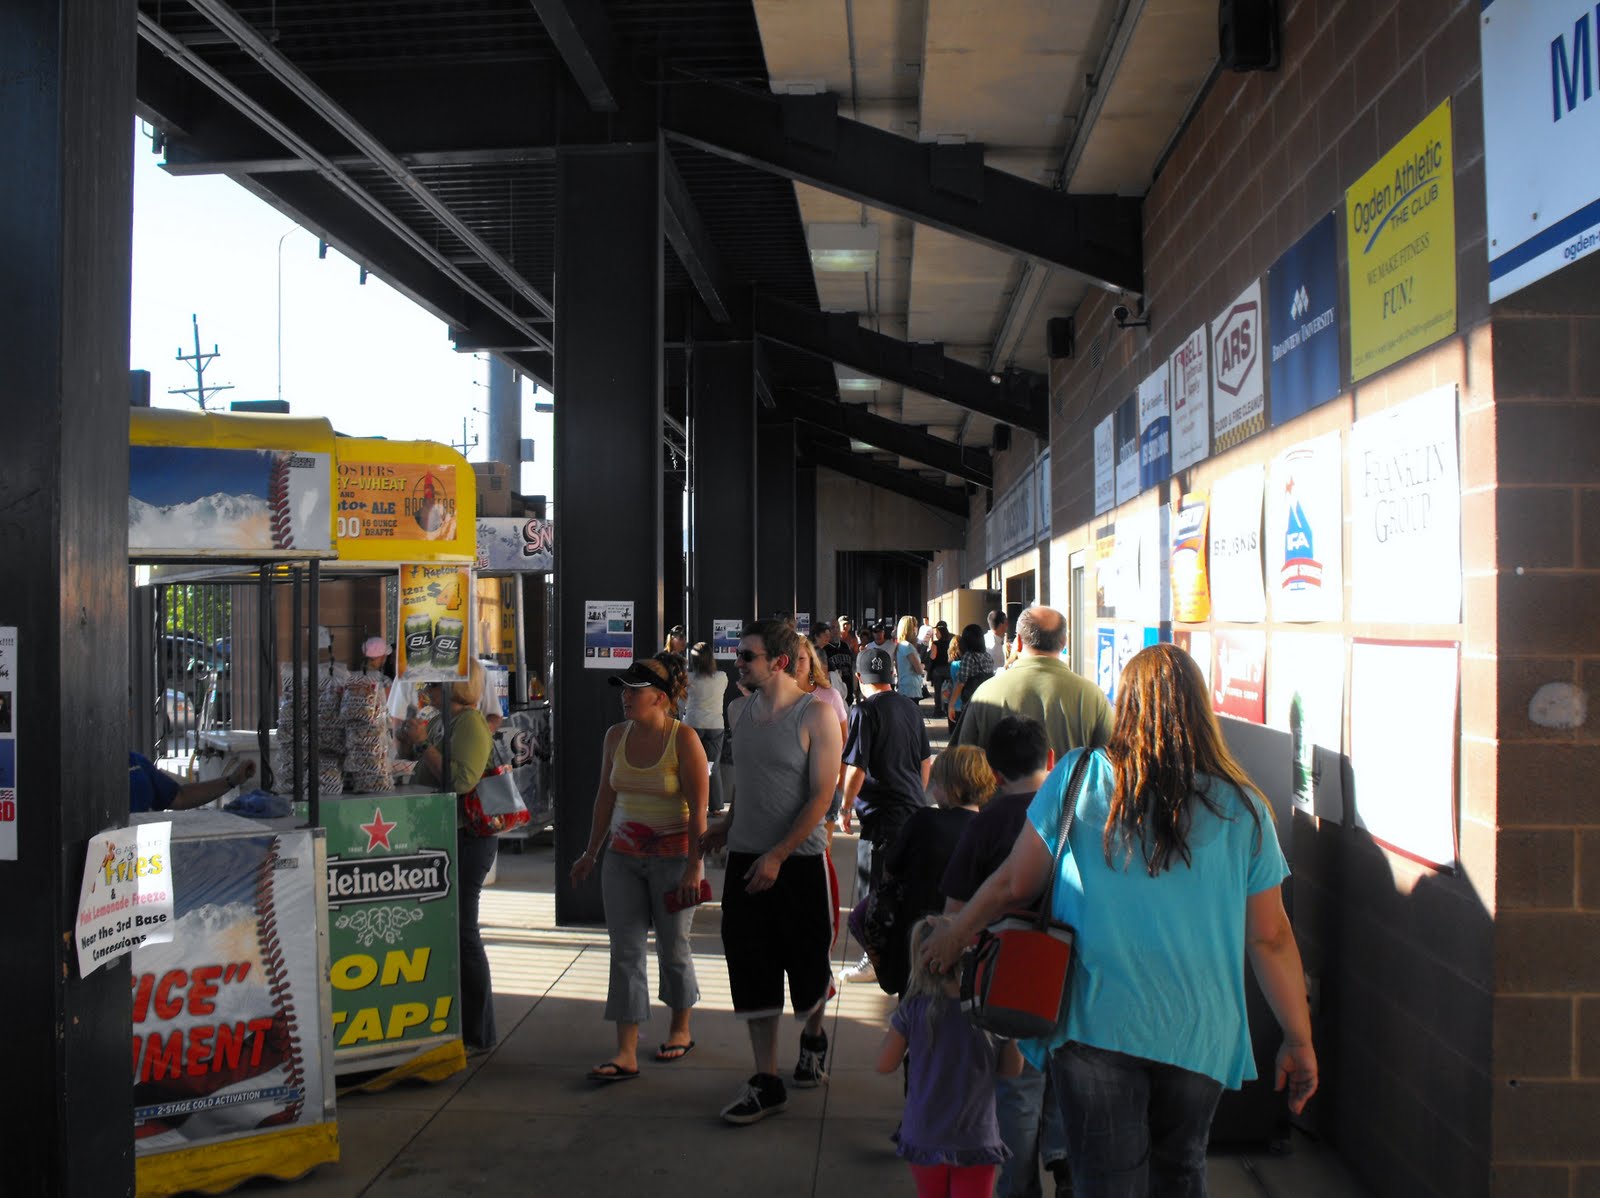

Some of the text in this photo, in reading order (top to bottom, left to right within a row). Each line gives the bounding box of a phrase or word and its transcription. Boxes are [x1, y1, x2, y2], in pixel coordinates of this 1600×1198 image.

[1551, 3, 1600, 124] M
[1353, 140, 1442, 235] Ogden Athletic
[1390, 183, 1439, 232] THE CLUB
[1564, 230, 1600, 260] ogden-
[1383, 276, 1413, 320] FUN!
[1301, 307, 1334, 343] UNIVERSITY
[1221, 318, 1251, 376] ARS
[338, 477, 407, 491] Y-WHEAT
[371, 502, 396, 514] ALE
[373, 519, 398, 528] OUNCE
[365, 528, 394, 537] DRAFTS
[411, 636, 430, 647] BL
[438, 639, 458, 650] BL
[105, 853, 163, 886] Fries
[327, 863, 440, 897] Heineken
[93, 898, 129, 919] Lemonade
[131, 891, 166, 906] Freeze
[111, 888, 116, 899] &
[81, 914, 167, 950] Near the 3rd Base
[92, 933, 147, 961] Concessions
[330, 947, 431, 991] ON
[333, 995, 452, 1046] TAP!
[157, 1090, 261, 1116] 2-STAGE COLD ACTIVATION
